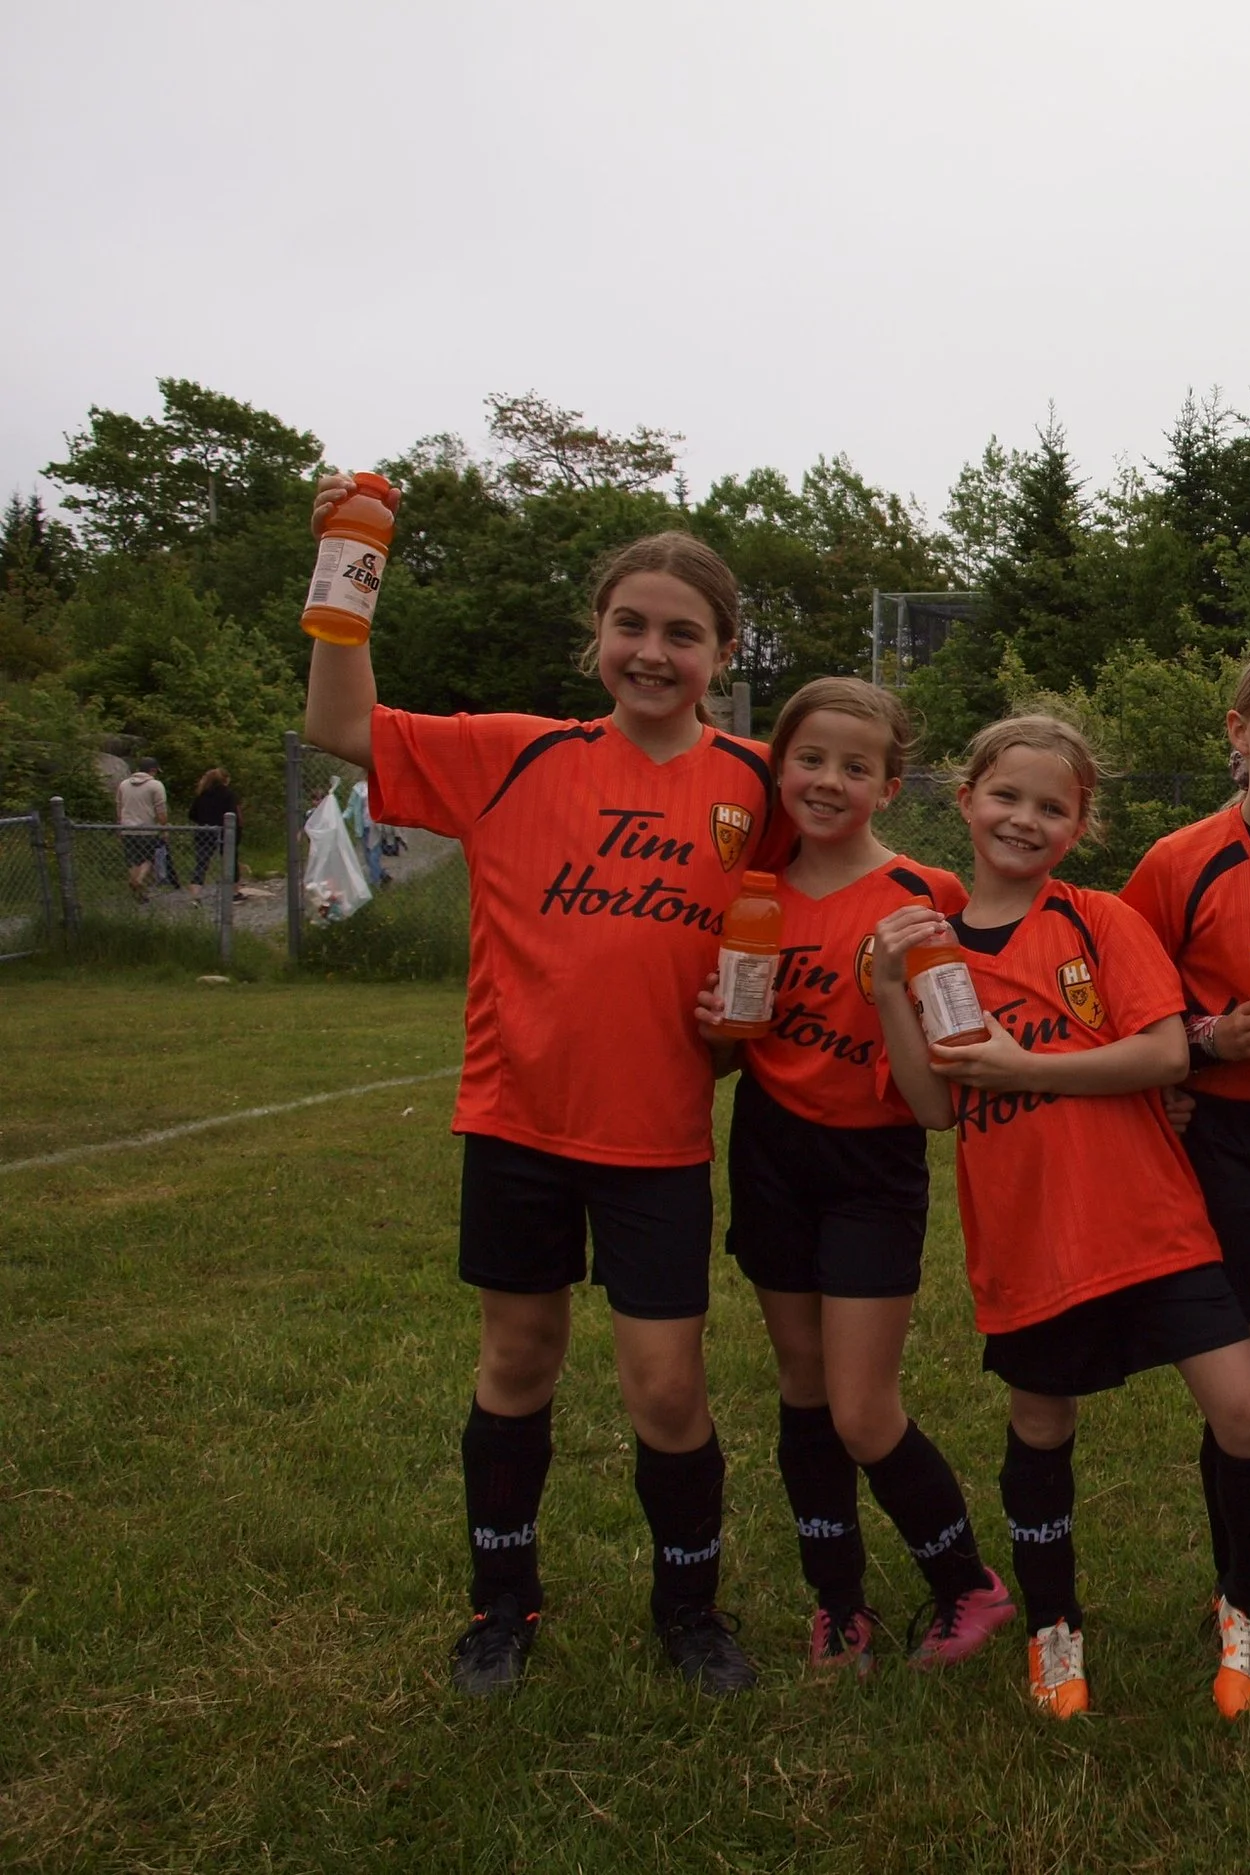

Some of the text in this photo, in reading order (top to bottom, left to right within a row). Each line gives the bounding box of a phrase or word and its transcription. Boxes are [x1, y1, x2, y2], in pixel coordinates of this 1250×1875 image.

[362, 553, 376, 570] G
[342, 565, 380, 591] ZERO
[718, 806, 752, 834] HCU
[597, 809, 695, 866] Tim
[540, 862, 725, 936] Hortons
[1063, 963, 1092, 986] HC
[770, 1003, 874, 1065] tons
[473, 1523, 535, 1549] timb
